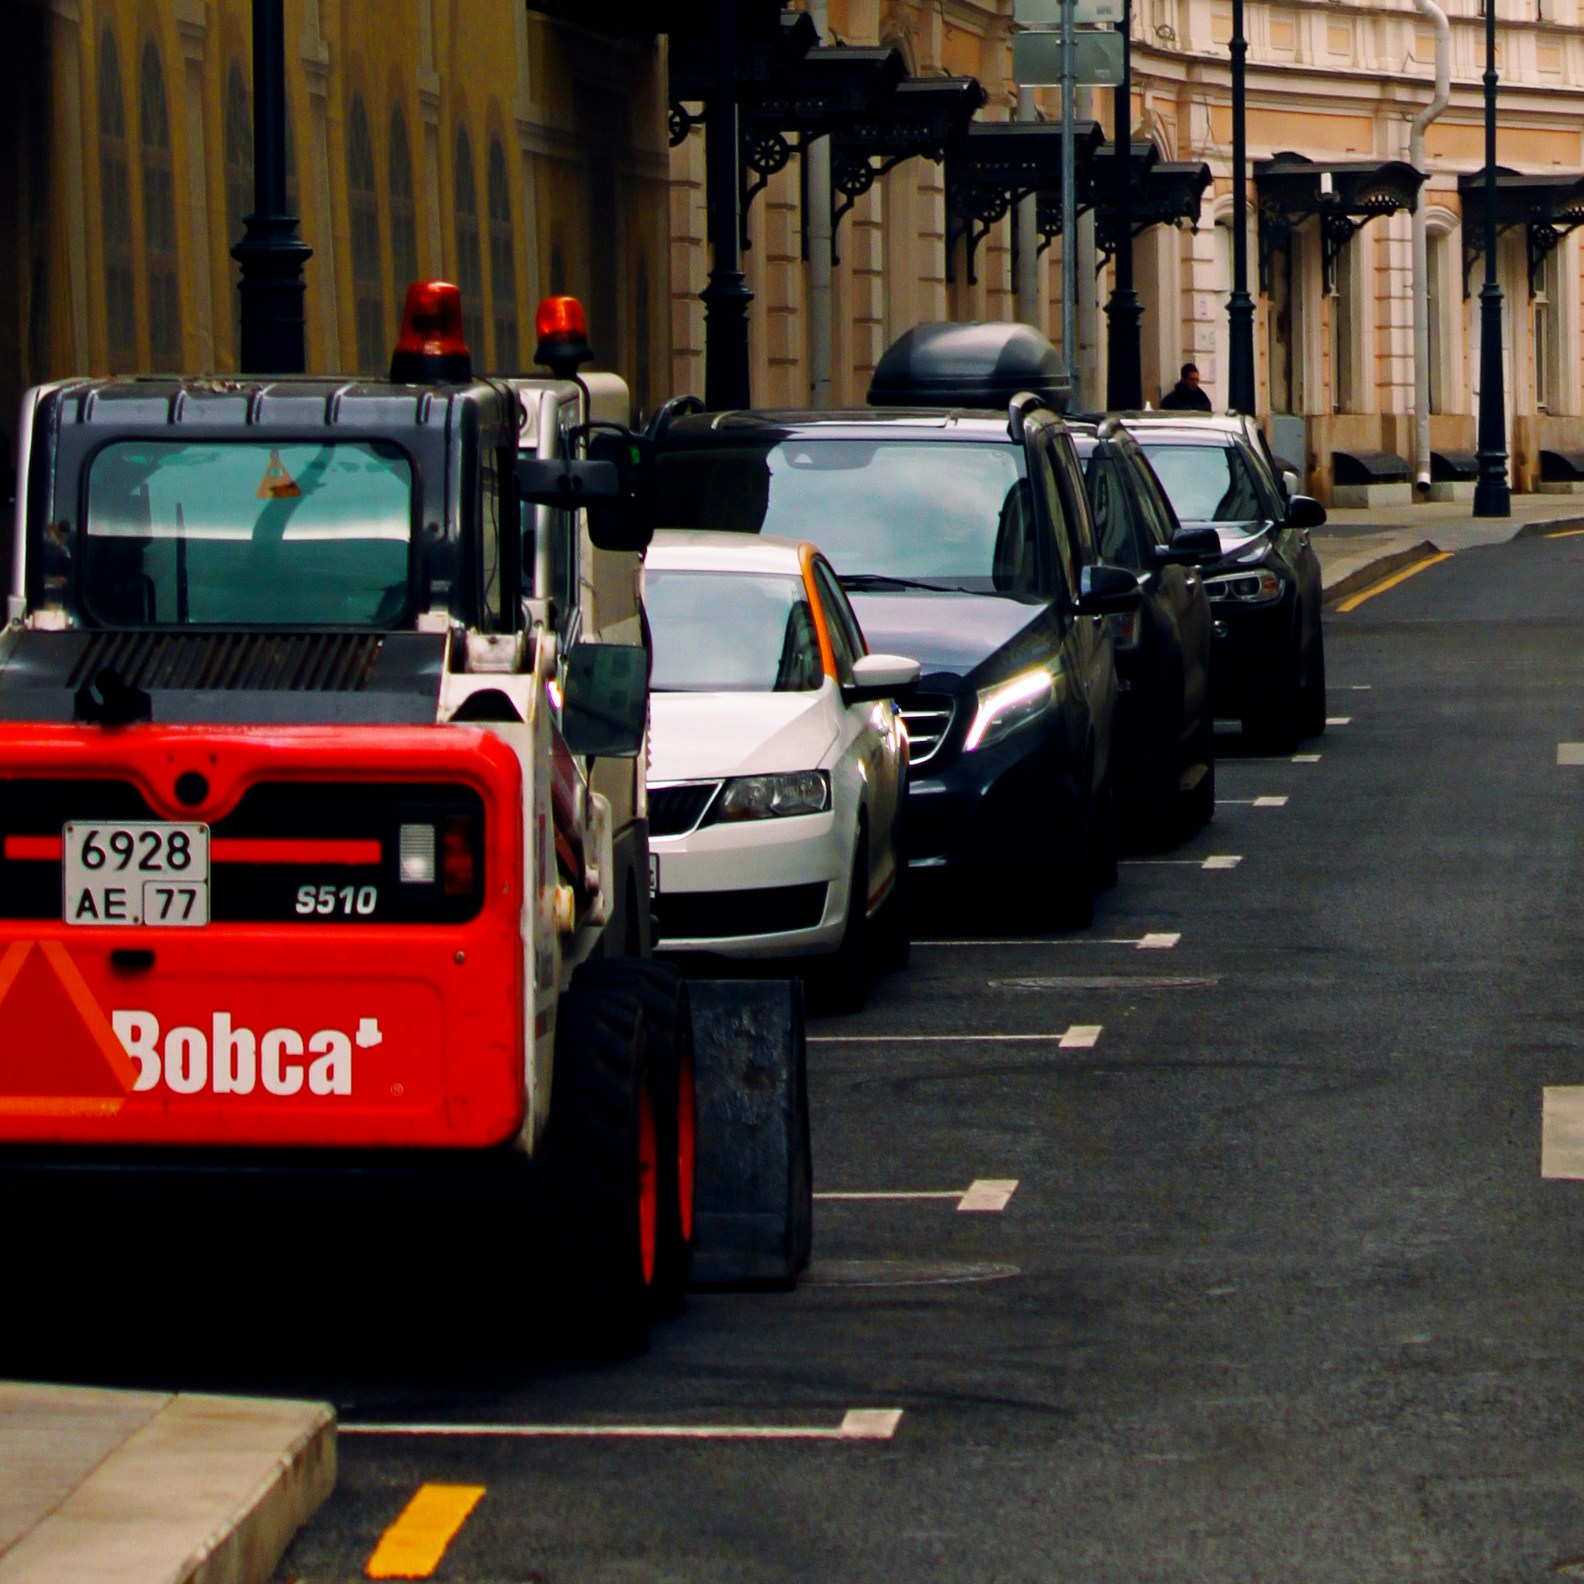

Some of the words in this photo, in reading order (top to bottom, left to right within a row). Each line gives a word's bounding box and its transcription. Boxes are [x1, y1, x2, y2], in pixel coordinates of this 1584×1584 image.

[81, 830, 191, 871] 6928
[76, 887, 127, 920] AE
[155, 888, 197, 920] 77
[295, 885, 378, 915] S510
